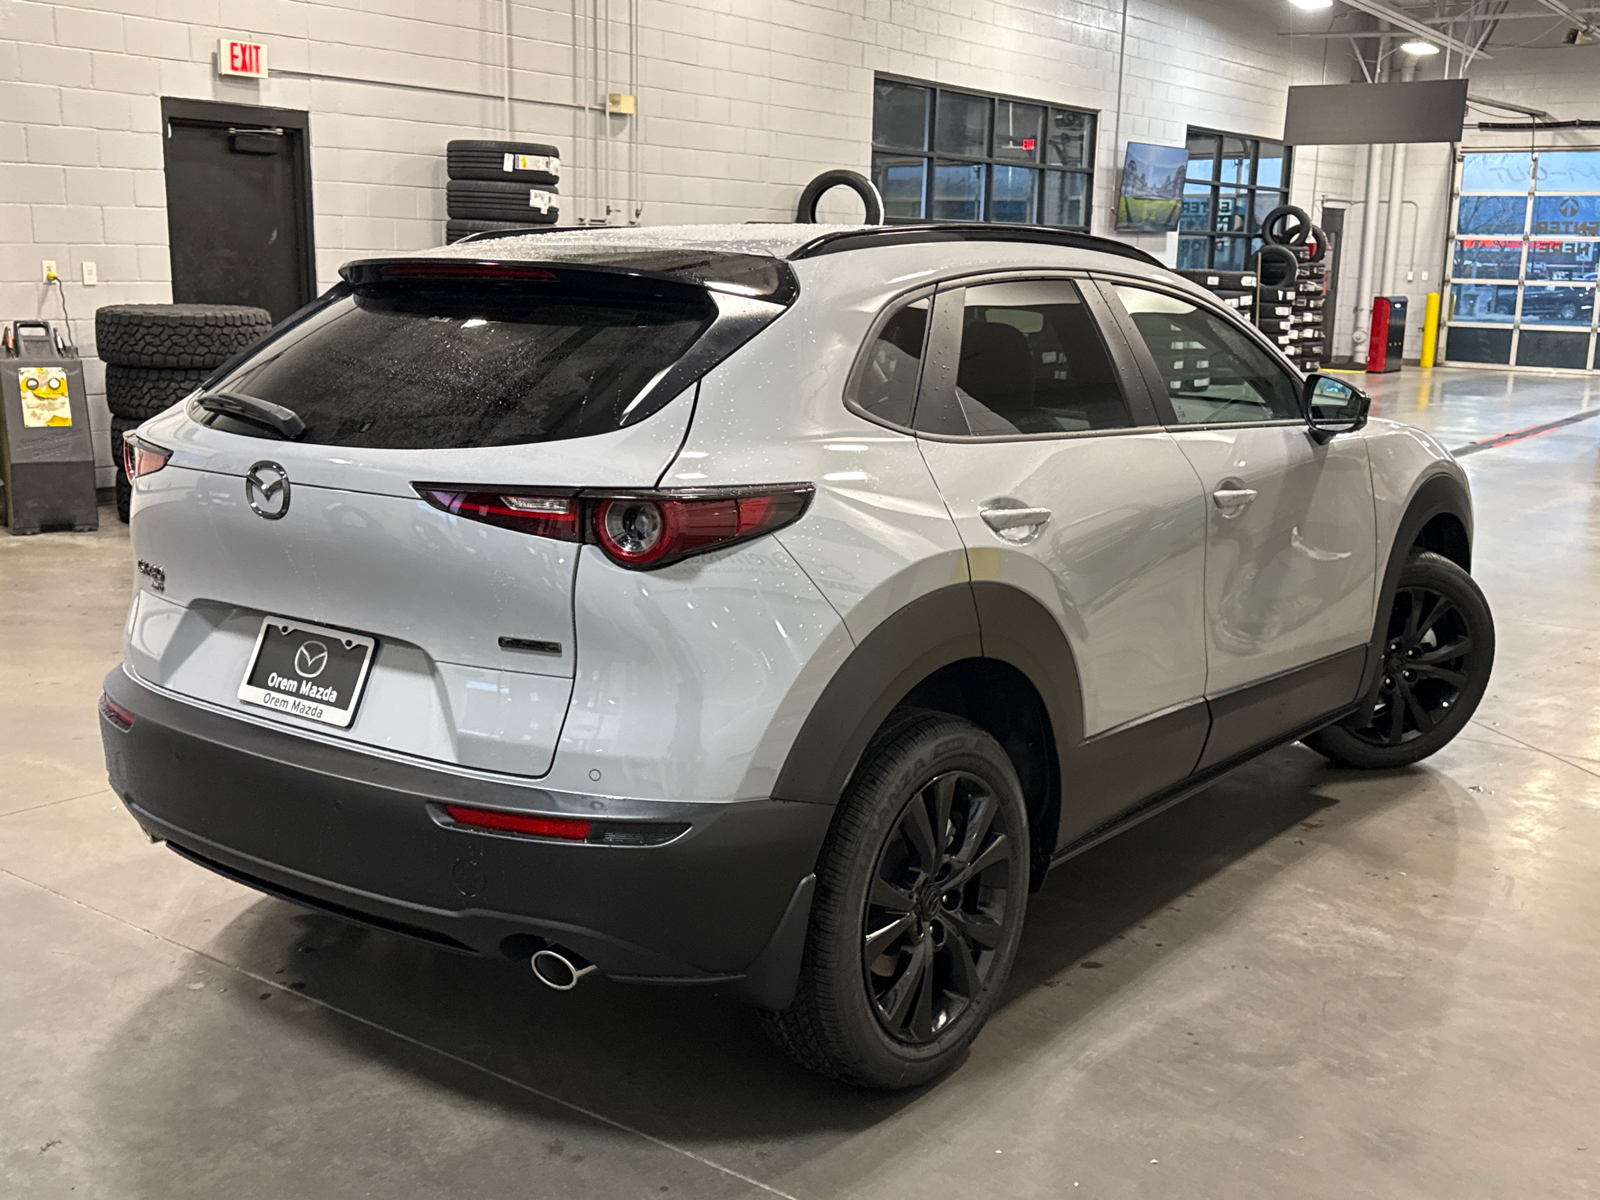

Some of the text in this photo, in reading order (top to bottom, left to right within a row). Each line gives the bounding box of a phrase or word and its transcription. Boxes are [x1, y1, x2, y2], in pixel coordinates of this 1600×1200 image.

[230, 42, 261, 74] EXIT
[267, 672, 338, 703] Orem Mazda
[263, 692, 323, 719] Orem Mazda
